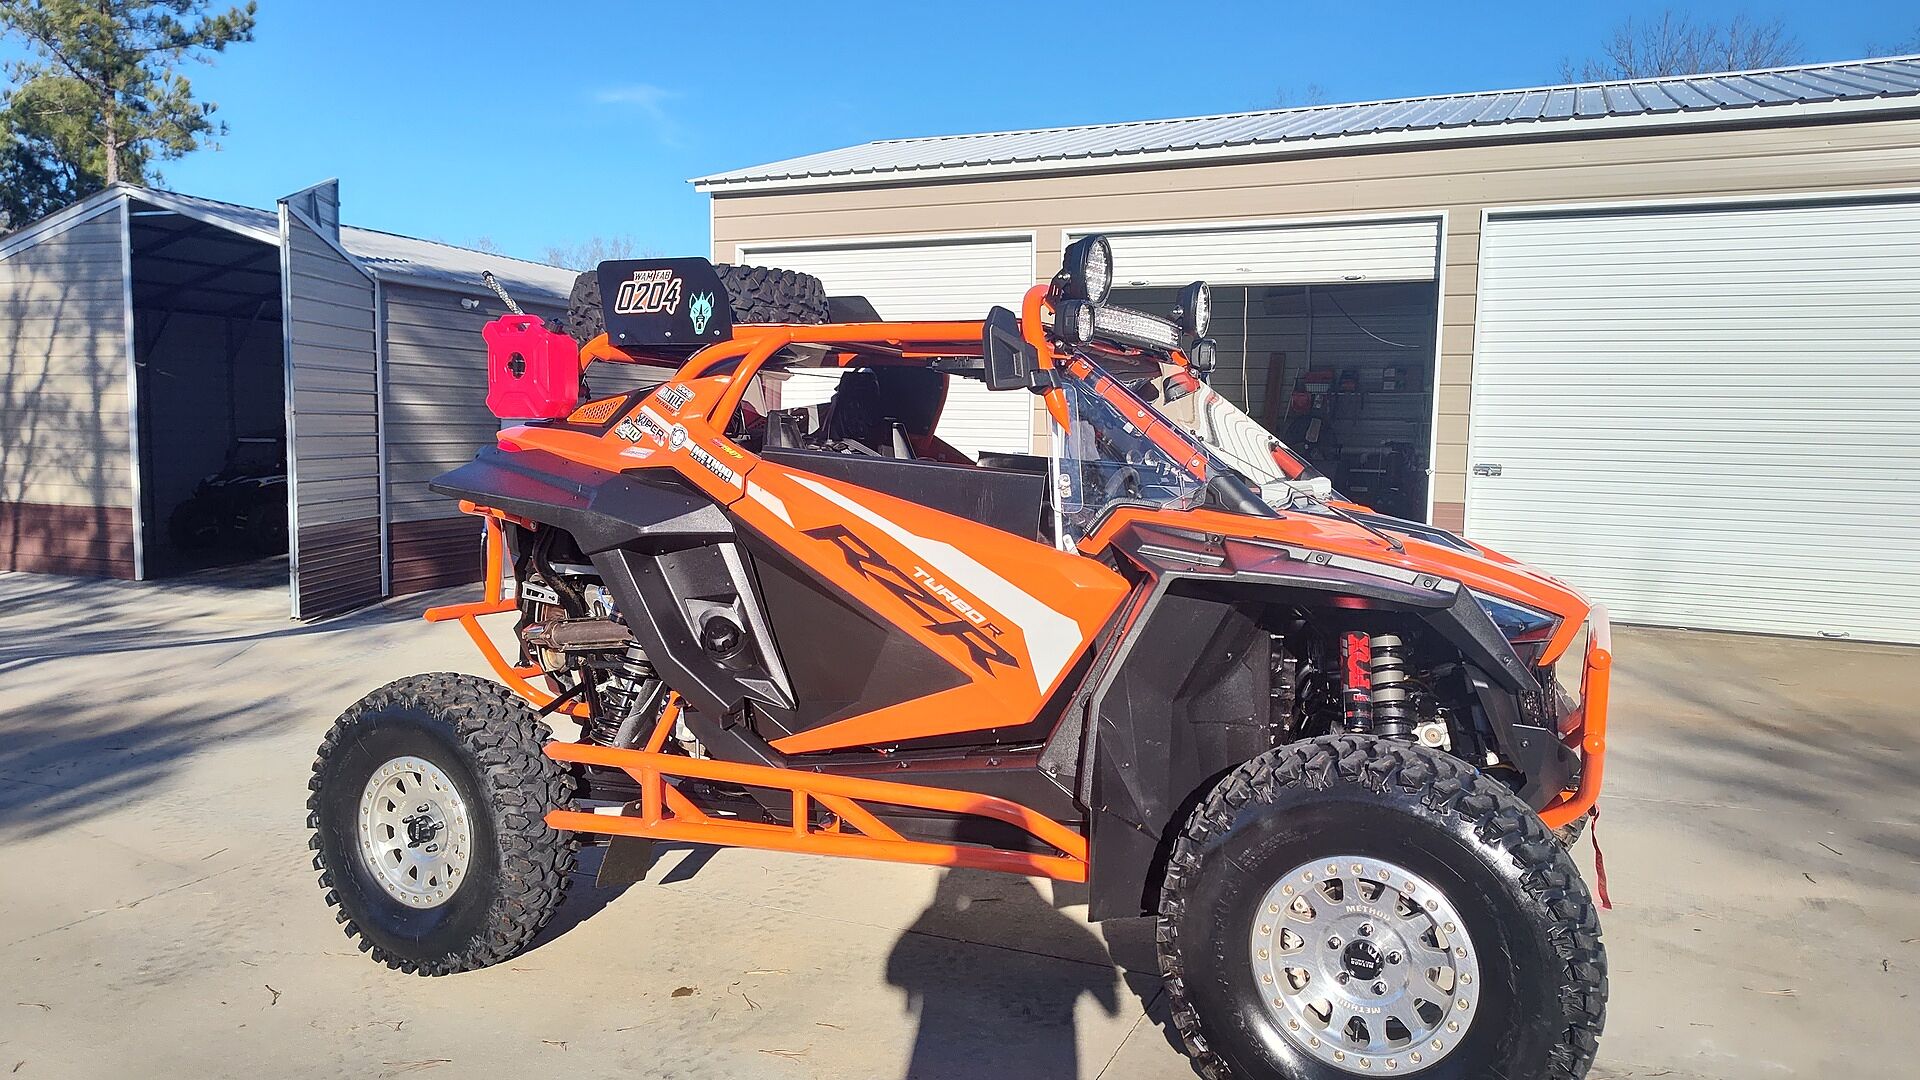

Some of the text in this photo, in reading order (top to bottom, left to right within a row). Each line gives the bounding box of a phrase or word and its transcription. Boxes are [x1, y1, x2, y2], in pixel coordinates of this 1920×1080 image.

[656, 270, 672, 280] FAB
[617, 280, 681, 314] 0204
[658, 386, 685, 410] BATTLE
[637, 413, 664, 439] VIPER
[693, 445, 733, 477] METHOD
[800, 524, 1020, 679] RZR
[913, 566, 1004, 639] TURBO R
[1348, 634, 1370, 689] FOX
[1346, 905, 1390, 921] METHOD
